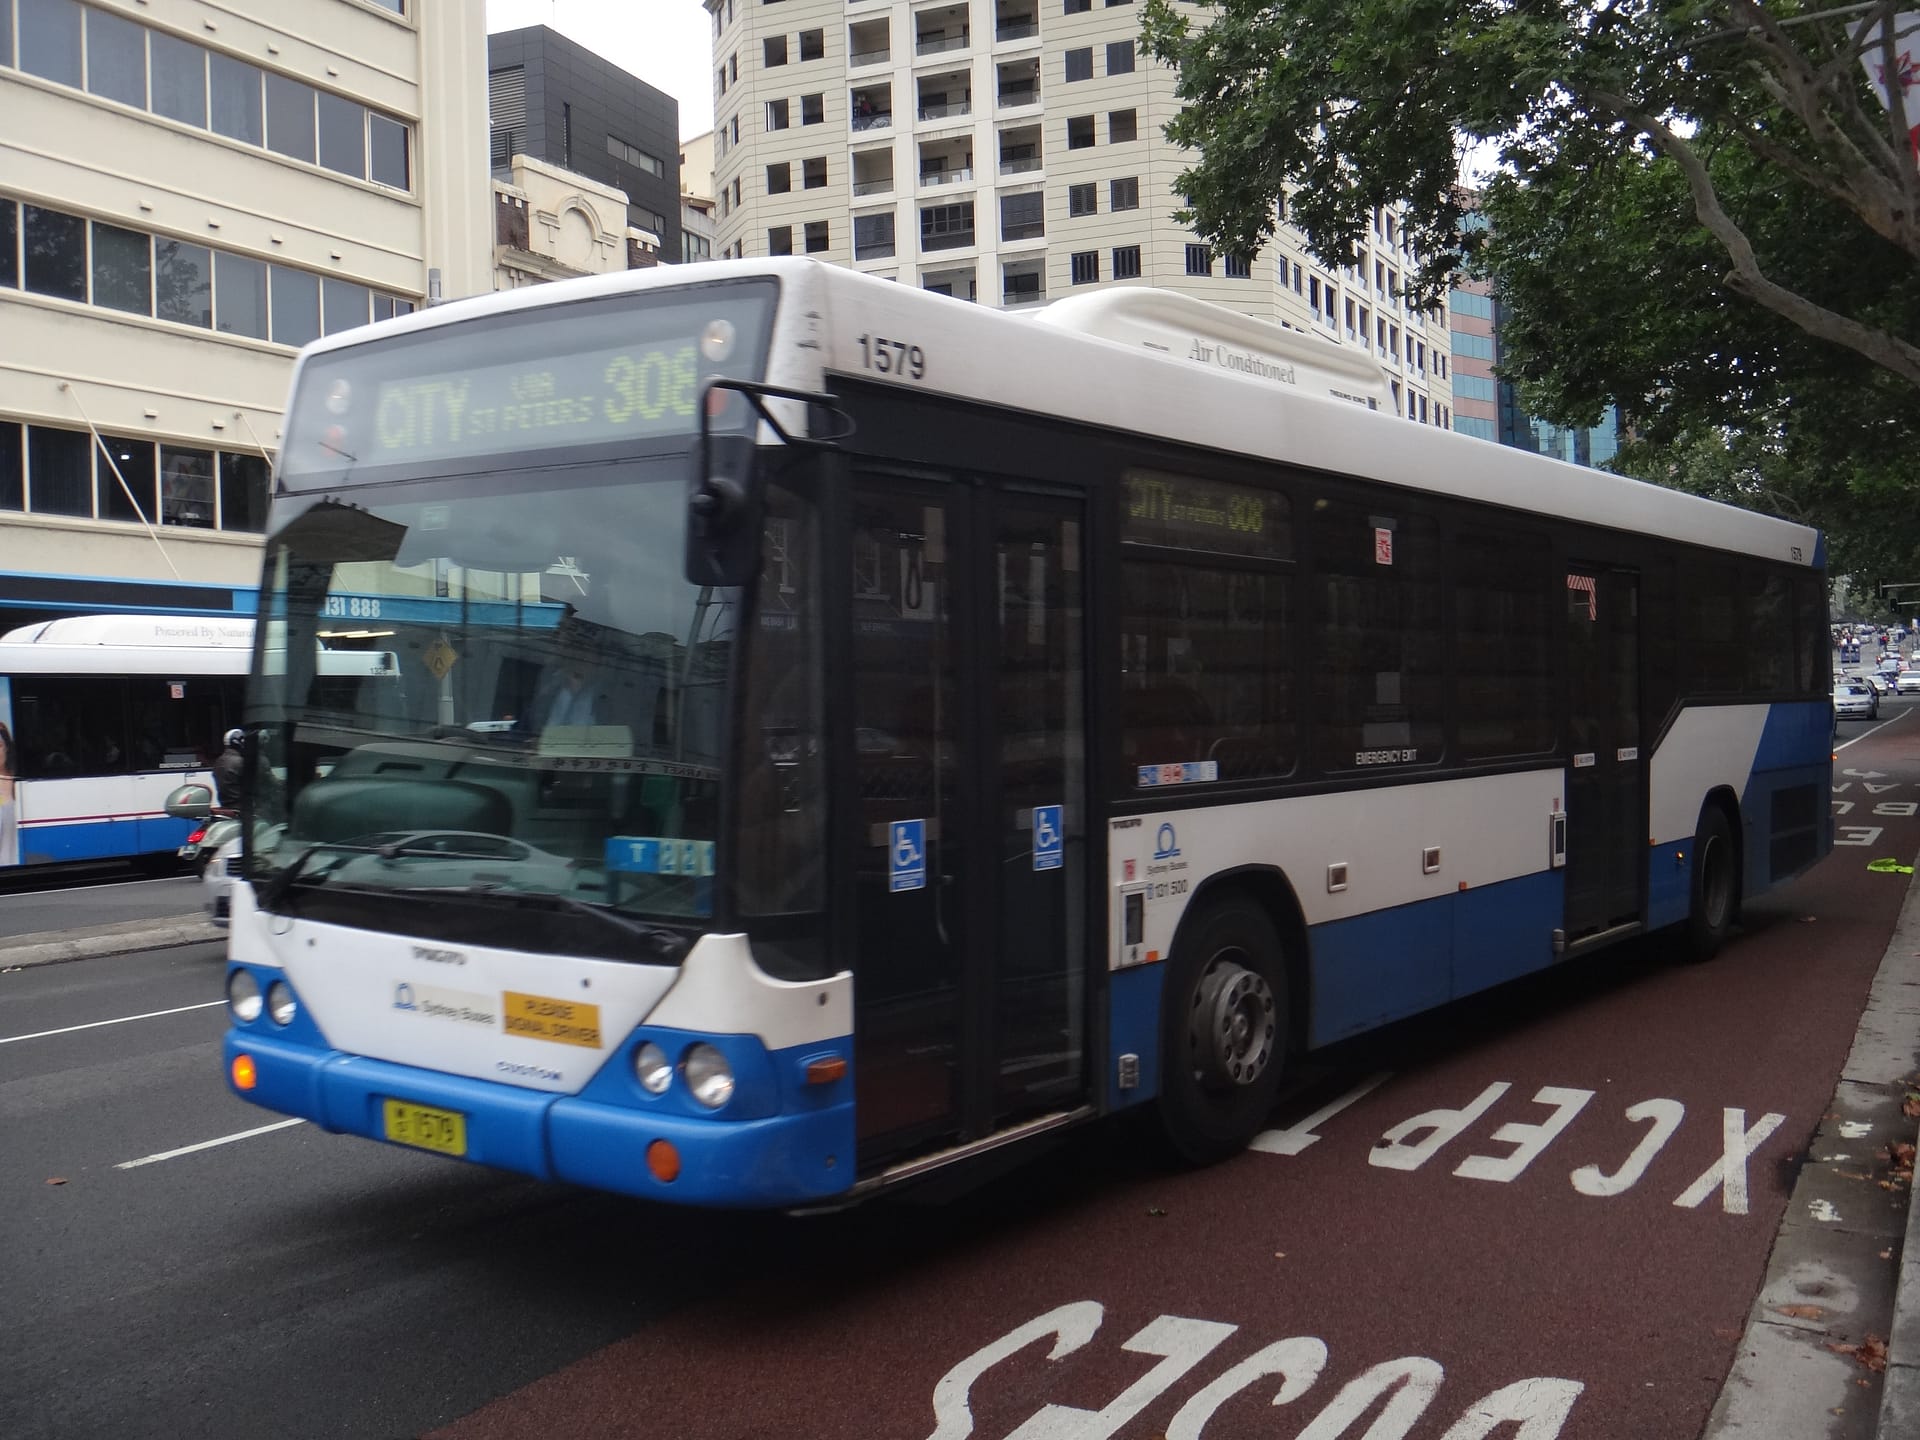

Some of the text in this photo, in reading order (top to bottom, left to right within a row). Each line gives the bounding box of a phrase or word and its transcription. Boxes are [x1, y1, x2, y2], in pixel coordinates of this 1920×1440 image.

[856, 333, 925, 380] 1579
[1189, 338, 1296, 385] Air Conditioned
[376, 378, 472, 448] CITY
[325, 596, 346, 616] 131
[1355, 750, 1400, 765] EMERGENCY
